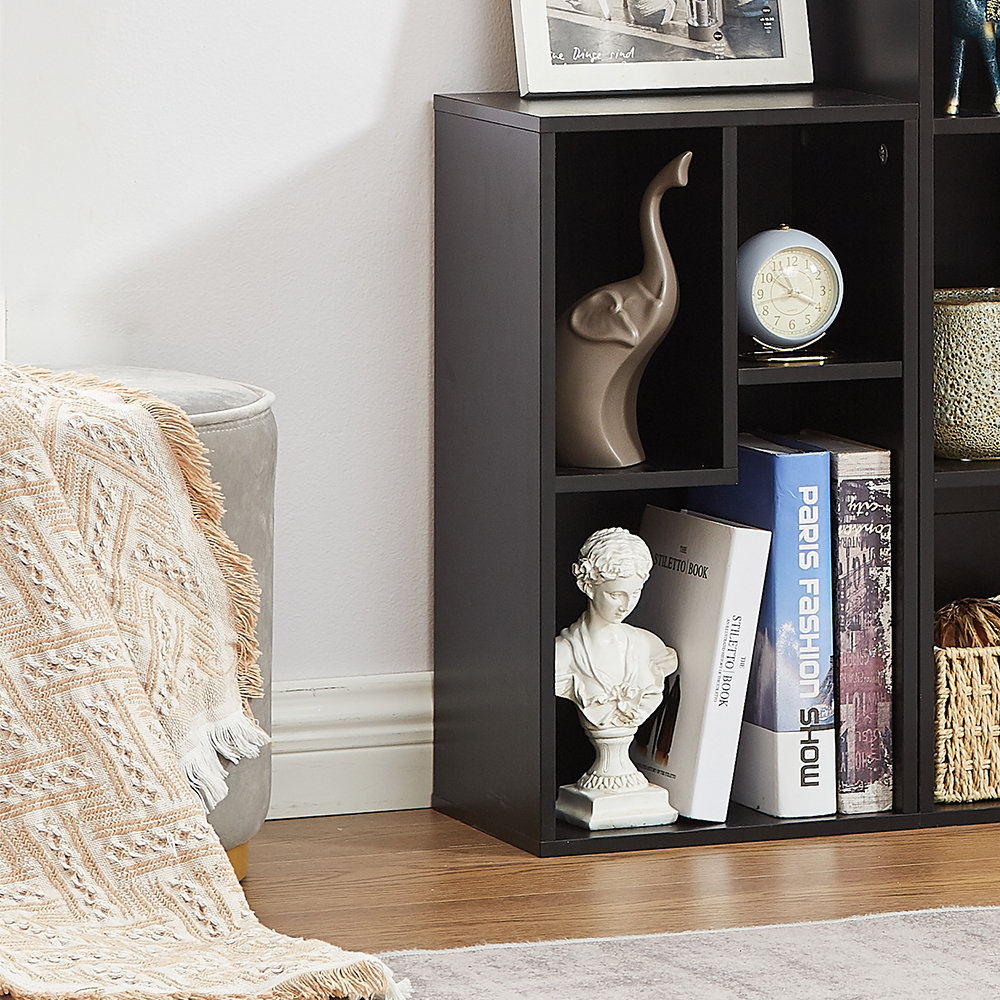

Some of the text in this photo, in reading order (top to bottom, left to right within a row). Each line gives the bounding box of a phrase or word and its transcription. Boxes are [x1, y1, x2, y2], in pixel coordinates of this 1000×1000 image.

[572, 46, 602, 63] Dinge
[609, 46, 635, 60] sind
[772, 261, 783, 271] 11
[786, 256, 798, 267] 12
[761, 273, 773, 283] 10
[815, 270, 821, 280] 2
[757, 289, 764, 299] 9
[819, 285, 826, 296] 3
[762, 305, 769, 316] 8
[815, 302, 821, 312] 4
[774, 315, 780, 325] 7
[805, 314, 811, 324] 5
[788, 319, 796, 330] 6
[654, 553, 709, 579] STILETTO BOOK
[718, 614, 742, 707] STILETTO BOOK
